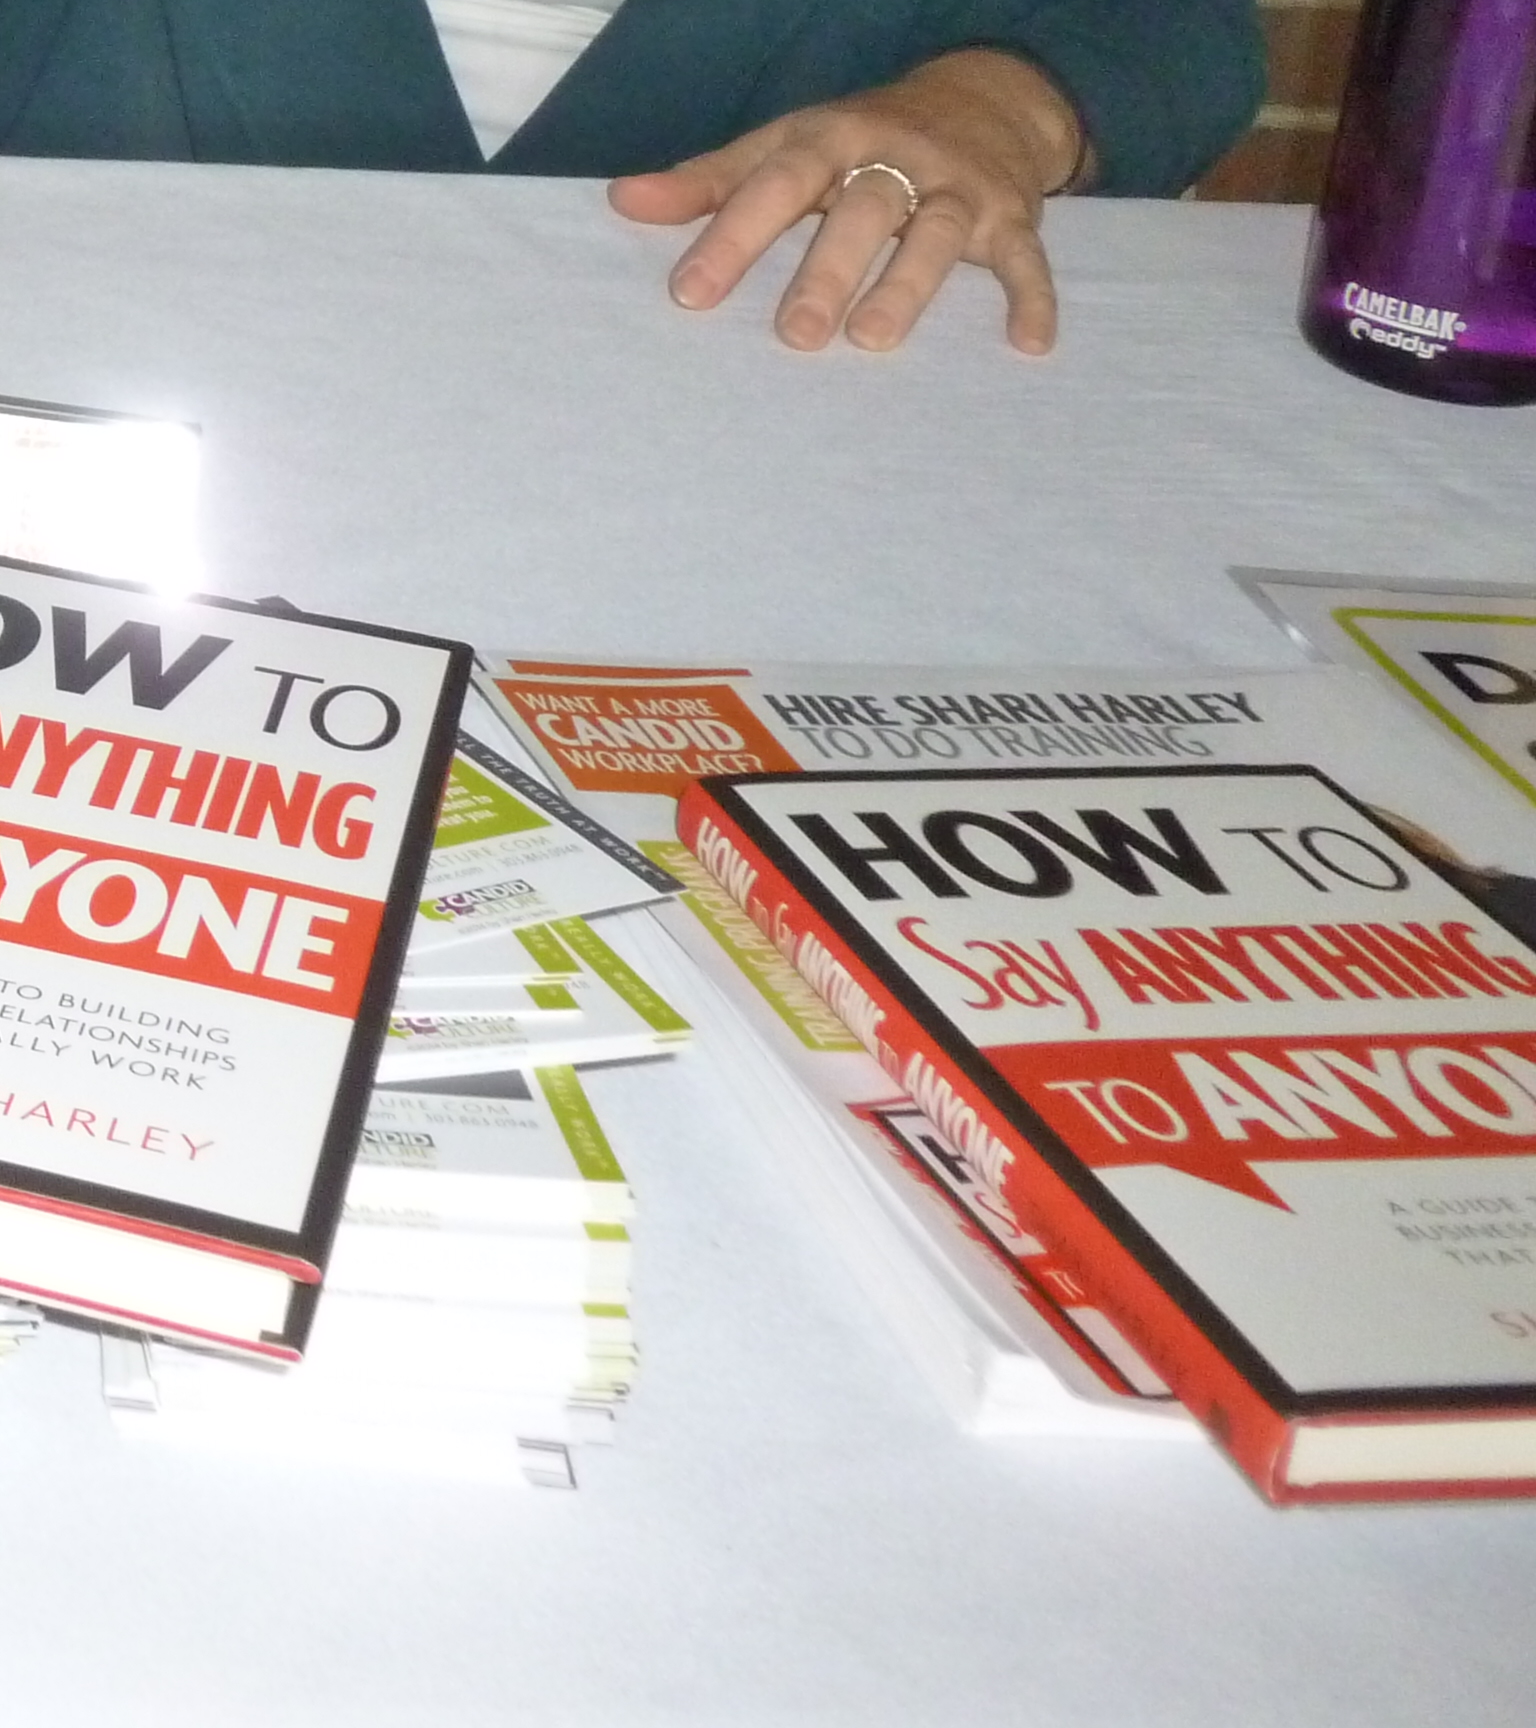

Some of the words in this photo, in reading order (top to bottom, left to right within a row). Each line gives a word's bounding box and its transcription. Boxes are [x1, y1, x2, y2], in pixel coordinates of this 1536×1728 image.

[251, 665, 405, 756] TO
[514, 691, 595, 715] WANT
[613, 698, 631, 715] A
[638, 698, 721, 717] MORE
[535, 713, 746, 751] CANDID
[762, 692, 904, 727] HIRE
[900, 692, 1057, 726] SHARI
[1054, 691, 1265, 724] HARLEY
[787, 725, 875, 760] TO
[875, 725, 963, 760] DO
[954, 725, 1216, 759] TRAINING
[786, 807, 1232, 902] HOW
[1221, 825, 1412, 895] TO
[696, 816, 759, 910] HOW
[901, 1051, 1015, 1192] ANYONE
[895, 916, 1103, 1033] Say
[1076, 921, 1536, 1005] ANYTHING
[57, 988, 235, 1048] BUILDING
[87, 1048, 209, 1092] WORK
[1043, 1077, 1190, 1145] TO
